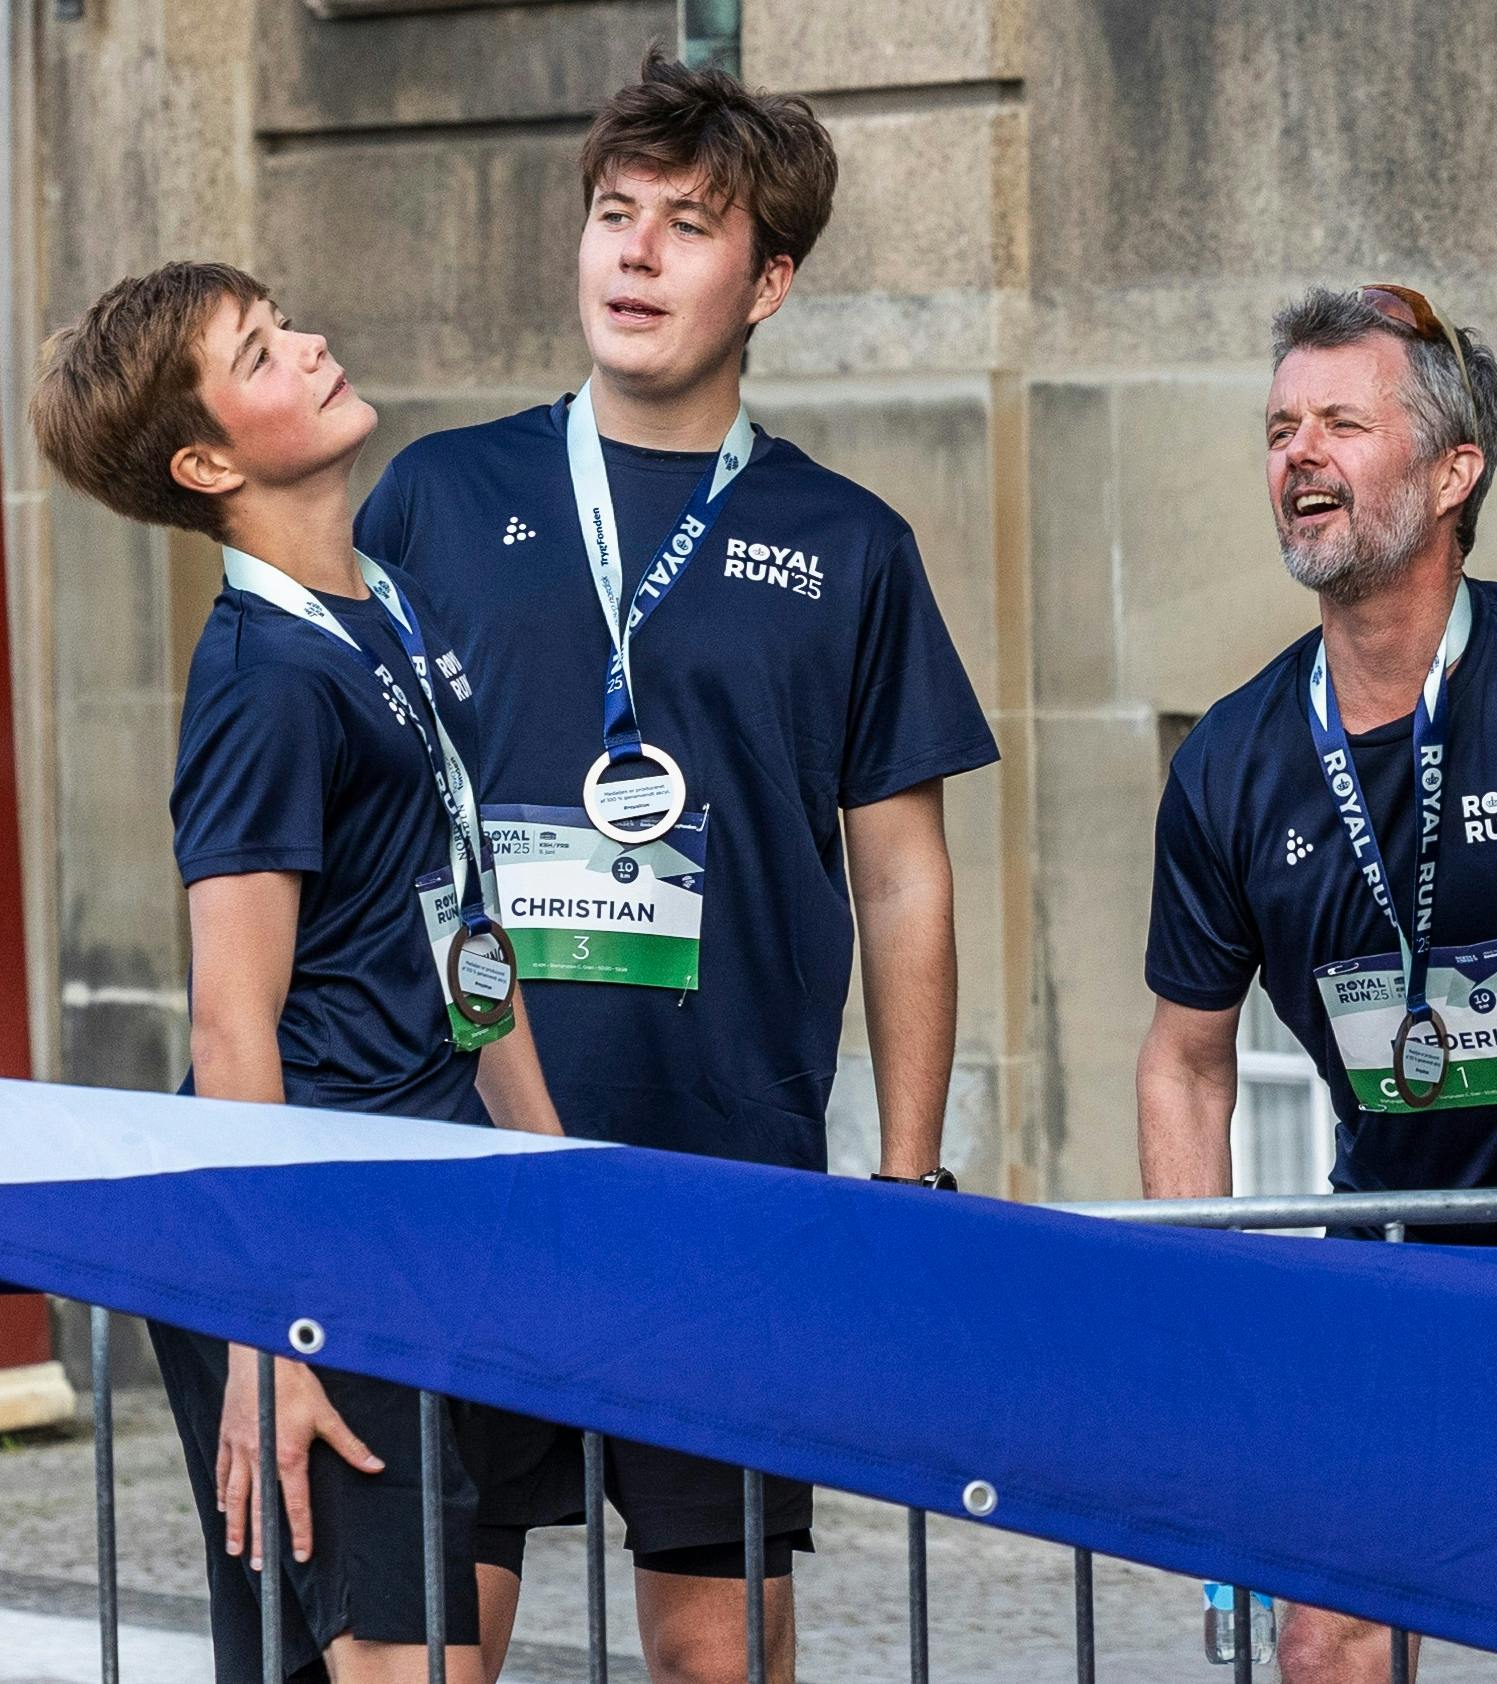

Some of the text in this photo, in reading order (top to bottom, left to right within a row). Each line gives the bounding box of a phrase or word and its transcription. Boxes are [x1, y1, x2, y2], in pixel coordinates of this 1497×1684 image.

[592, 506, 609, 567] TrygFonden
[638, 514, 706, 599] ROYAL
[726, 538, 824, 579] ROYAL
[1323, 749, 1371, 859] ROYAL
[1417, 744, 1443, 932] ROYAL RUN
[617, 862, 634, 872] 10
[434, 893, 458, 912] ROY
[510, 897, 655, 923] CHRISTIAN
[572, 935, 590, 960] 3
[1335, 977, 1386, 994] ROYAL
[1473, 992, 1490, 1005] 10
[1456, 1066, 1469, 1089] 1
